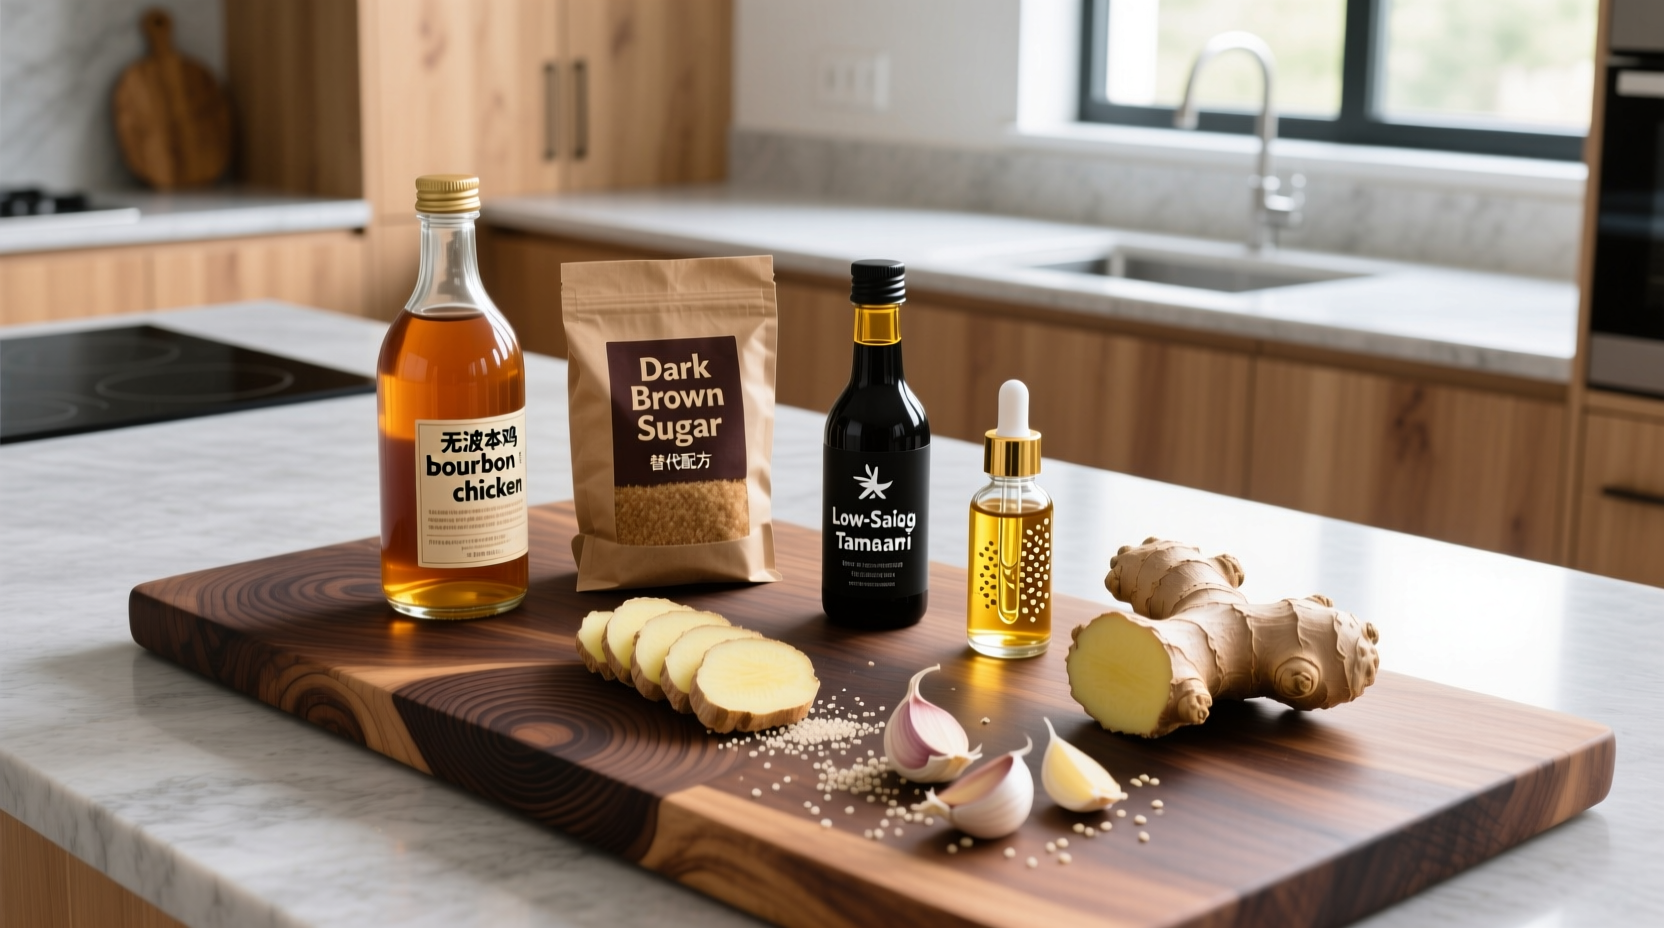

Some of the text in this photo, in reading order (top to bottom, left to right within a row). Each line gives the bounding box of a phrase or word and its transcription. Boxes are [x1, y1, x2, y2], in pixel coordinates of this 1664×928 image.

[640, 353, 712, 381] Dark
[631, 385, 724, 411] Brown
[441, 426, 518, 453] 无波本鸡
[637, 415, 722, 447] Sugar
[426, 452, 515, 476] bourbon
[650, 451, 712, 471] 替代配方
[453, 476, 522, 502] chicken
